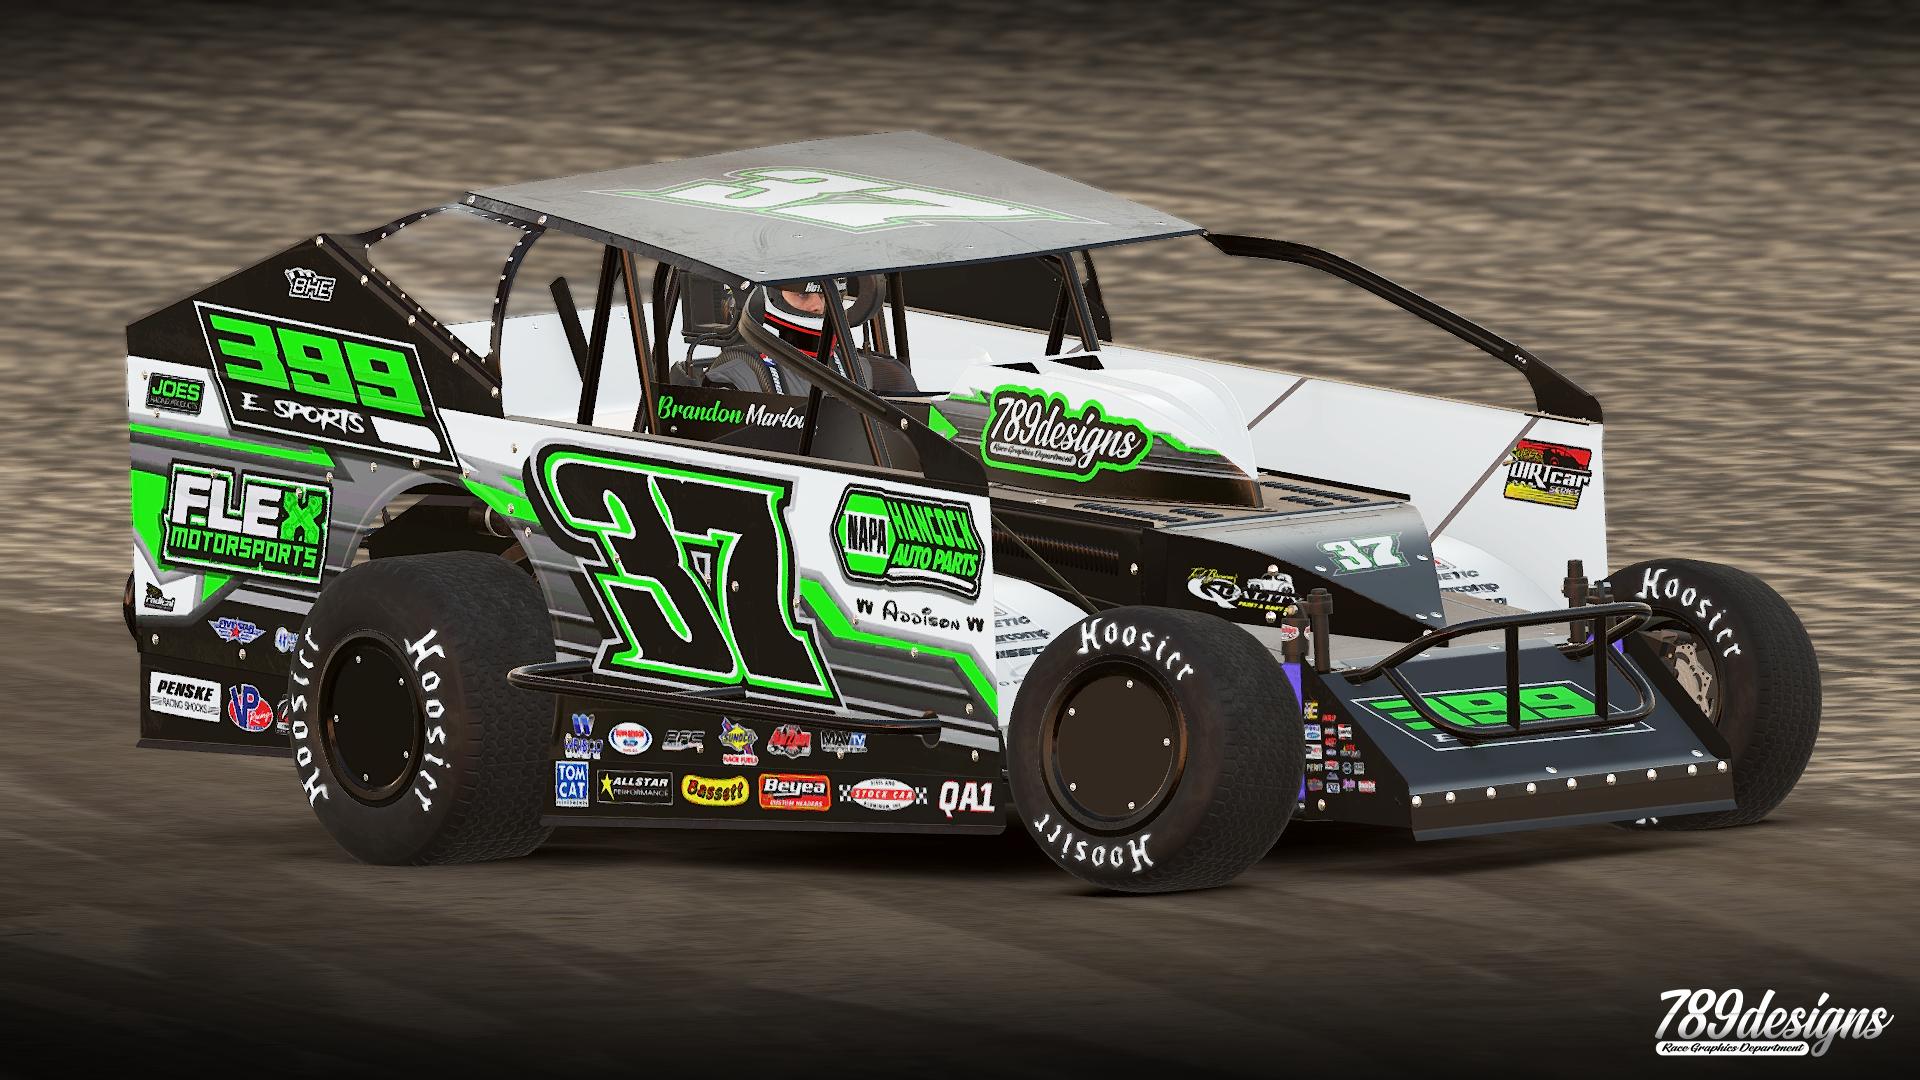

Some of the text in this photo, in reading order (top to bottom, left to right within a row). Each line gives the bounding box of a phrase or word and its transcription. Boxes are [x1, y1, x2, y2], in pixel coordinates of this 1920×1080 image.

[606, 167, 1090, 232] 37
[290, 275, 336, 301] BHE
[209, 314, 425, 417] 399
[152, 379, 200, 401] JOES
[657, 395, 744, 424] Brandon
[240, 391, 365, 435] E SPORTS
[990, 396, 1142, 469] 789designs
[171, 472, 324, 545] FLEX
[847, 501, 978, 555] NAPA HANCOCK
[170, 526, 318, 570] MOTORSPORTS
[891, 543, 978, 577] AUTO PARTS
[1320, 533, 1407, 573] 37
[536, 452, 836, 698] 37
[1635, 567, 1742, 657] Hoosier
[1077, 618, 1193, 680] Hoosier
[157, 680, 215, 701] PENSKE
[229, 684, 260, 729] VP
[404, 628, 452, 812] Hoosier
[558, 765, 585, 780] TOM
[558, 782, 586, 798] CAT
[613, 777, 669, 787] ALLSTAR
[613, 788, 669, 797] PERFORMANCE
[687, 779, 744, 801] Bassett
[763, 778, 825, 796] Beyea
[855, 789, 913, 799] STOCK CAR
[939, 780, 996, 819] QA1
[1033, 814, 1154, 872] Hoosier
